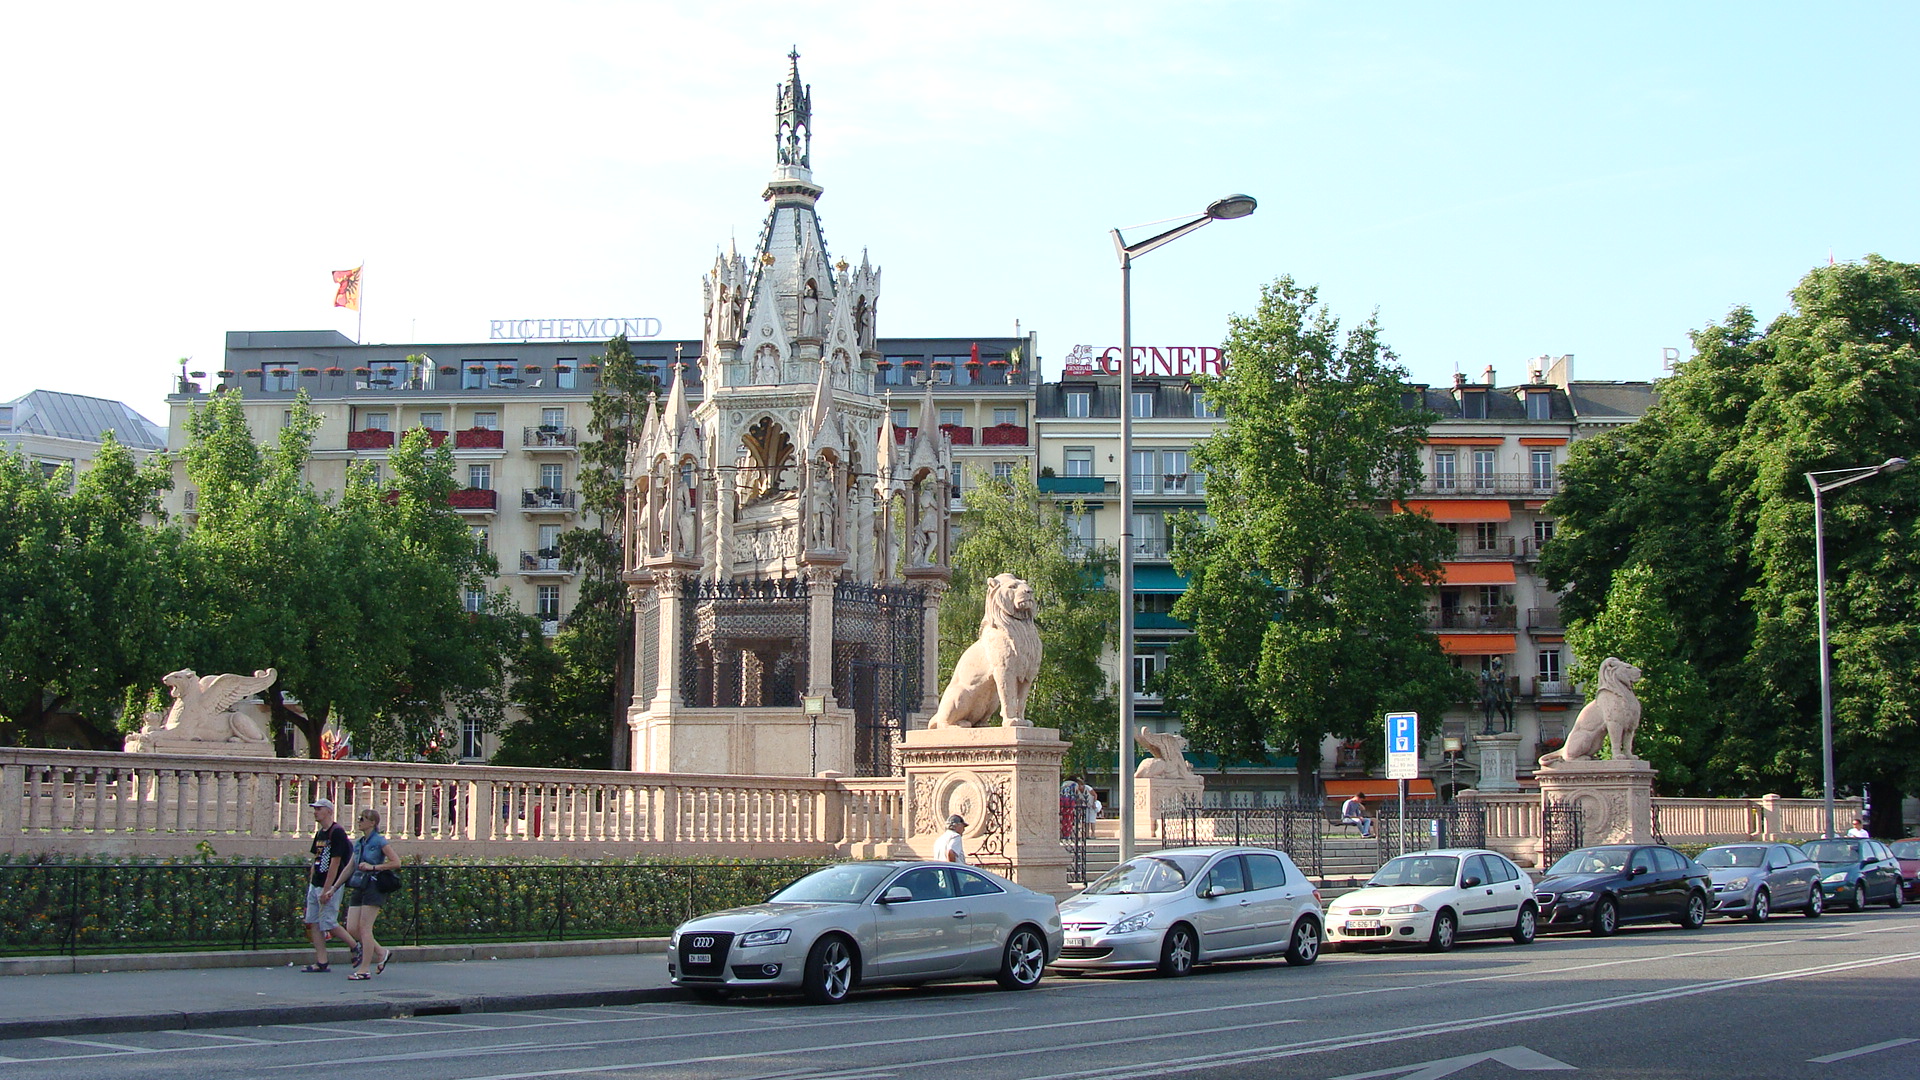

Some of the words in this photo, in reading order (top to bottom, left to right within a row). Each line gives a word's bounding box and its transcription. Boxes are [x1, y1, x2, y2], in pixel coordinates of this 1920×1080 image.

[490, 318, 662, 339] RICHEMOND
[1101, 346, 1230, 376] GENER
[1397, 719, 1408, 737] P
